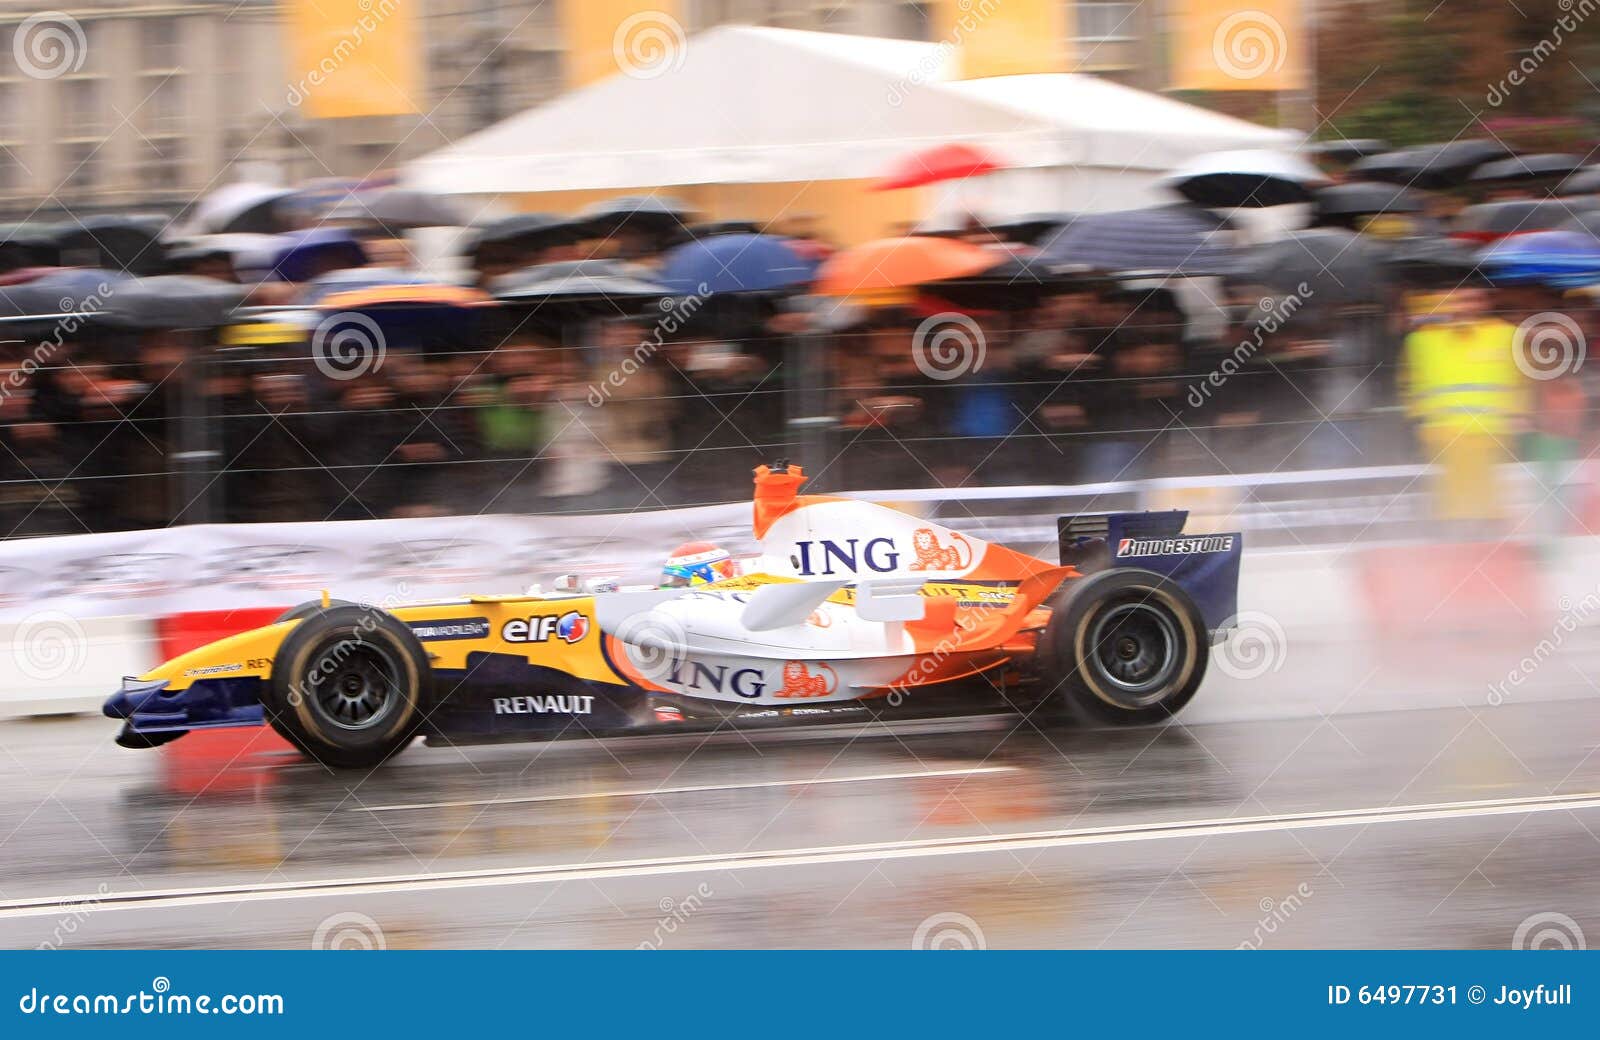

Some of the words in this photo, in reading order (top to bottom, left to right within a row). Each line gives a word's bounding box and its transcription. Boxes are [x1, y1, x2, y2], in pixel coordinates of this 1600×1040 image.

[796, 537, 900, 575] ING
[1117, 537, 1233, 557] BRIDGESTONE
[502, 615, 558, 642] elf
[666, 658, 766, 698] ING
[493, 695, 595, 714] RENAULT
